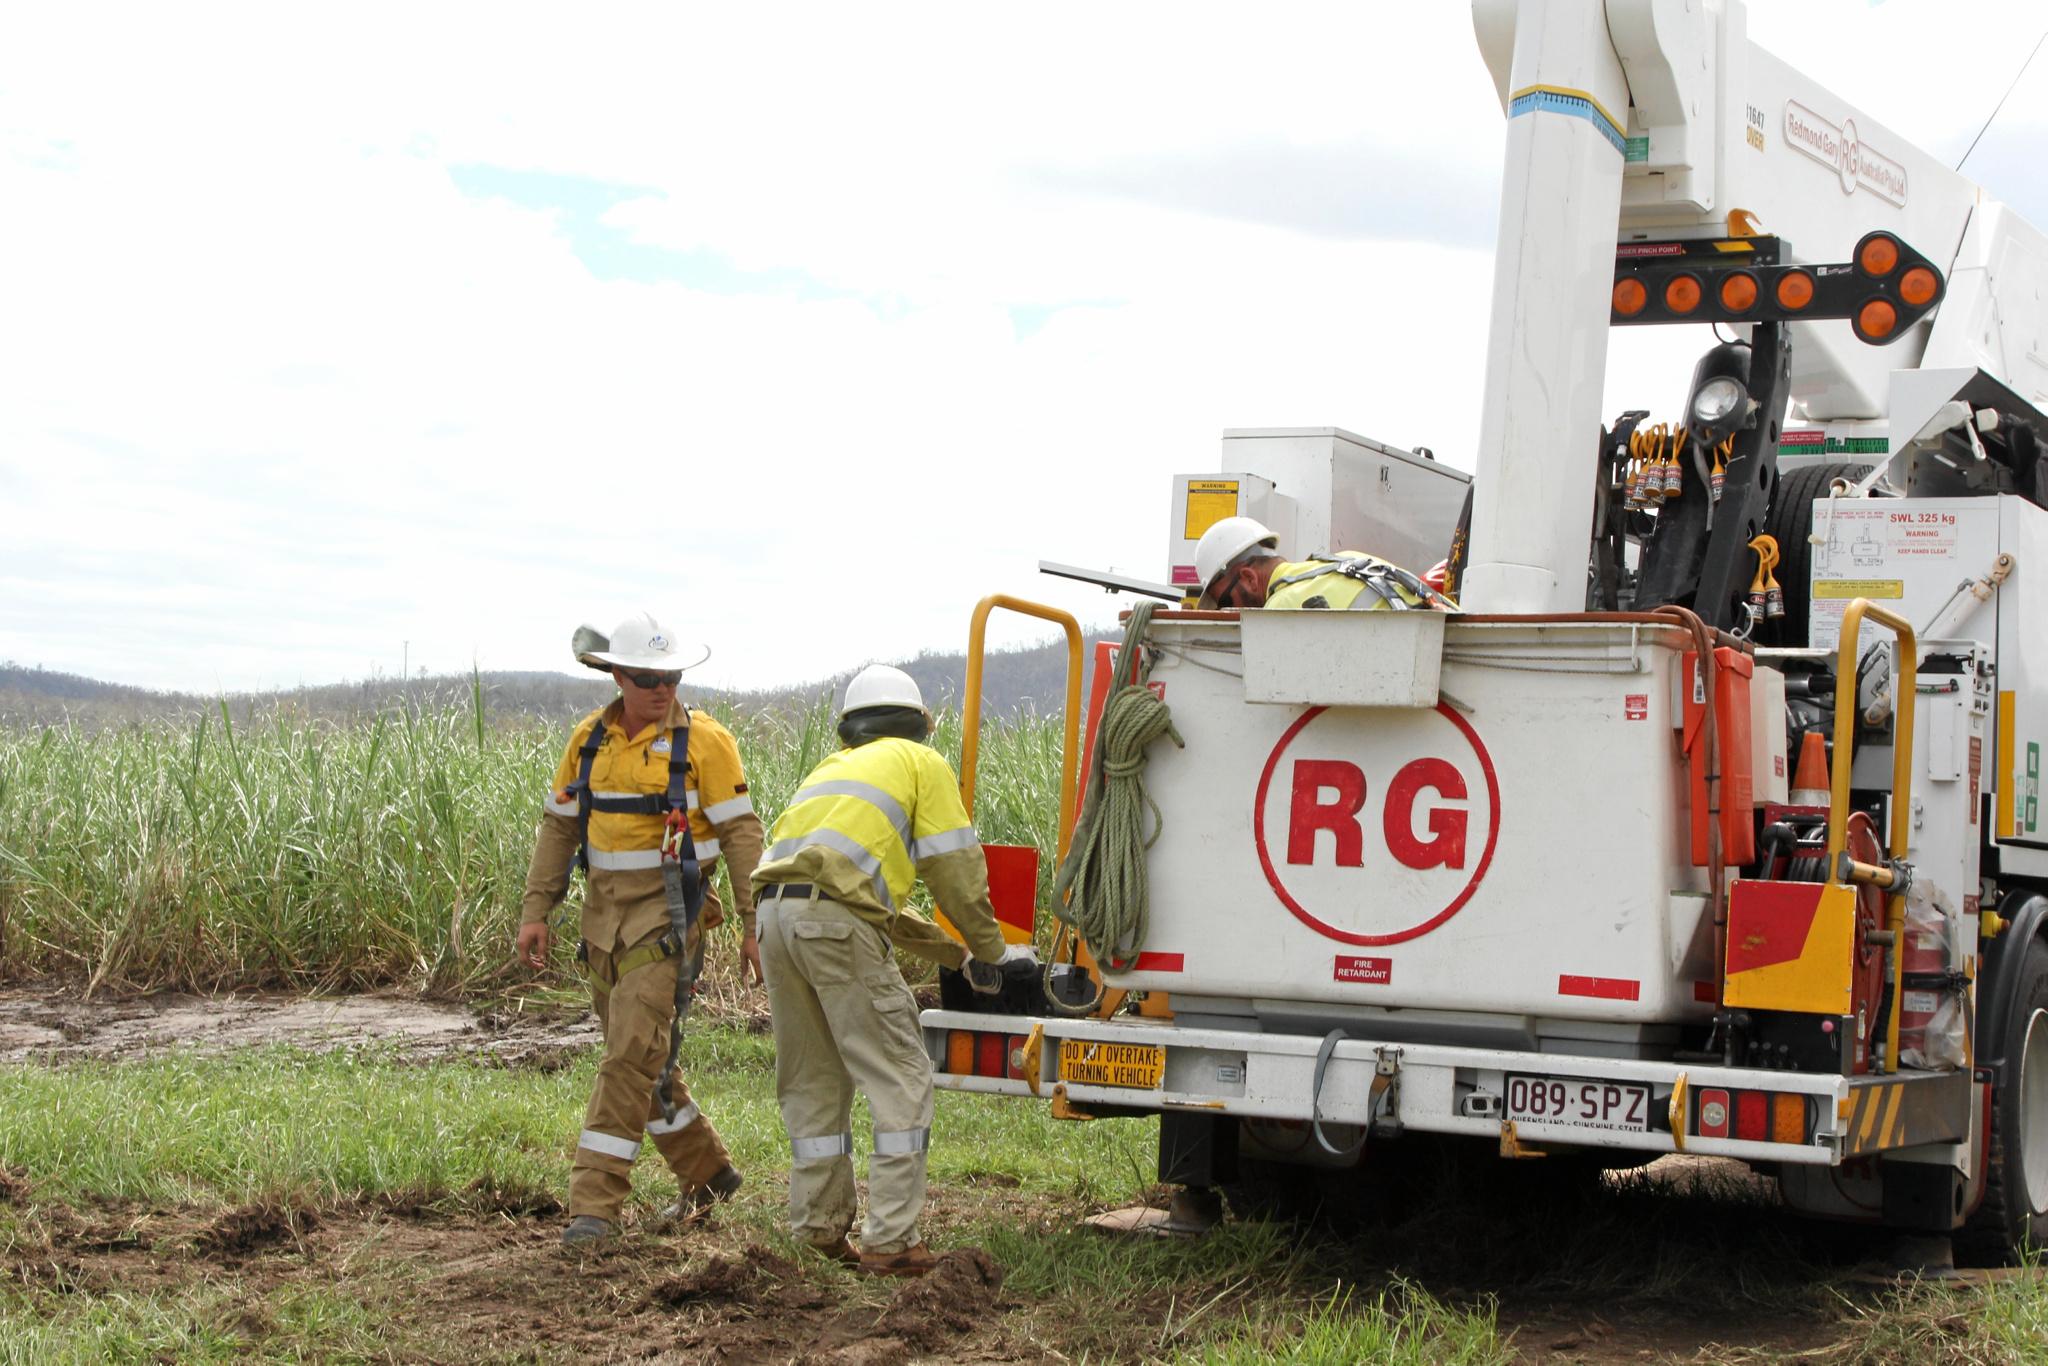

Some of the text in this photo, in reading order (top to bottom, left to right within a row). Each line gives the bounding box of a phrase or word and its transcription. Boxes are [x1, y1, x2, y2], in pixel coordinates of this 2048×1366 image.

[1788, 113, 1822, 149] Redmond
[1824, 133, 1838, 164] Gary
[1842, 139, 1857, 175] RG
[1638, 247, 1657, 255] PINCH
[1890, 513, 1914, 523] SWL
[1918, 513, 1938, 523] 325
[1942, 513, 1955, 525] kg
[1287, 757, 1468, 870] RG
[1354, 960, 1373, 968] FIRE
[1337, 968, 1388, 979] RETARDANT
[1066, 1042, 1159, 1067] DO NOT OVERTAKE
[1067, 1062, 1156, 1087] TURNING VEHICLE
